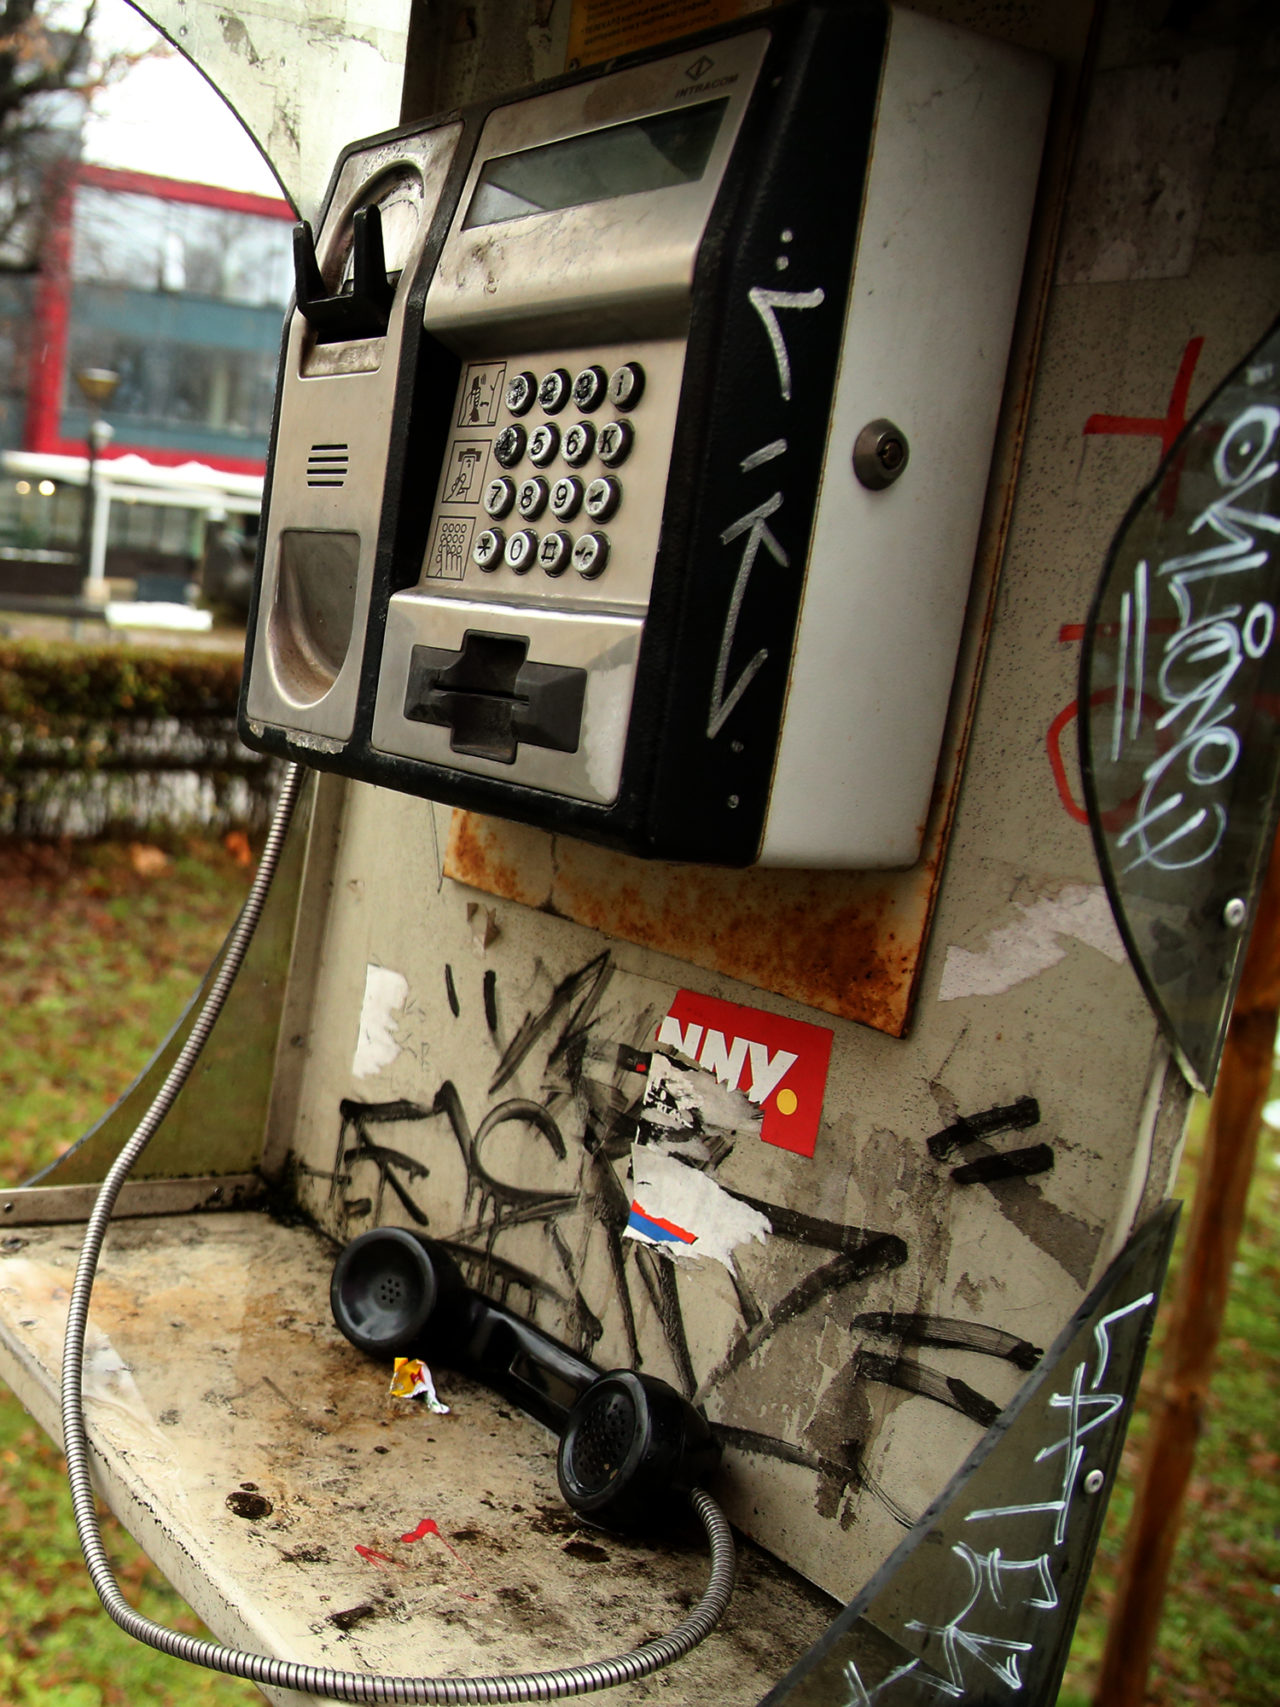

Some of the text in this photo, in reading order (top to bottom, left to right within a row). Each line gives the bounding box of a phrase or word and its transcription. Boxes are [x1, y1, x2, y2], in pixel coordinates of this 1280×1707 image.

[675, 73, 739, 98] INTRACOM
[530, 432, 545, 455] 5
[565, 430, 580, 455] 6
[600, 429, 617, 453] K
[489, 484, 568, 509] 7 8 9
